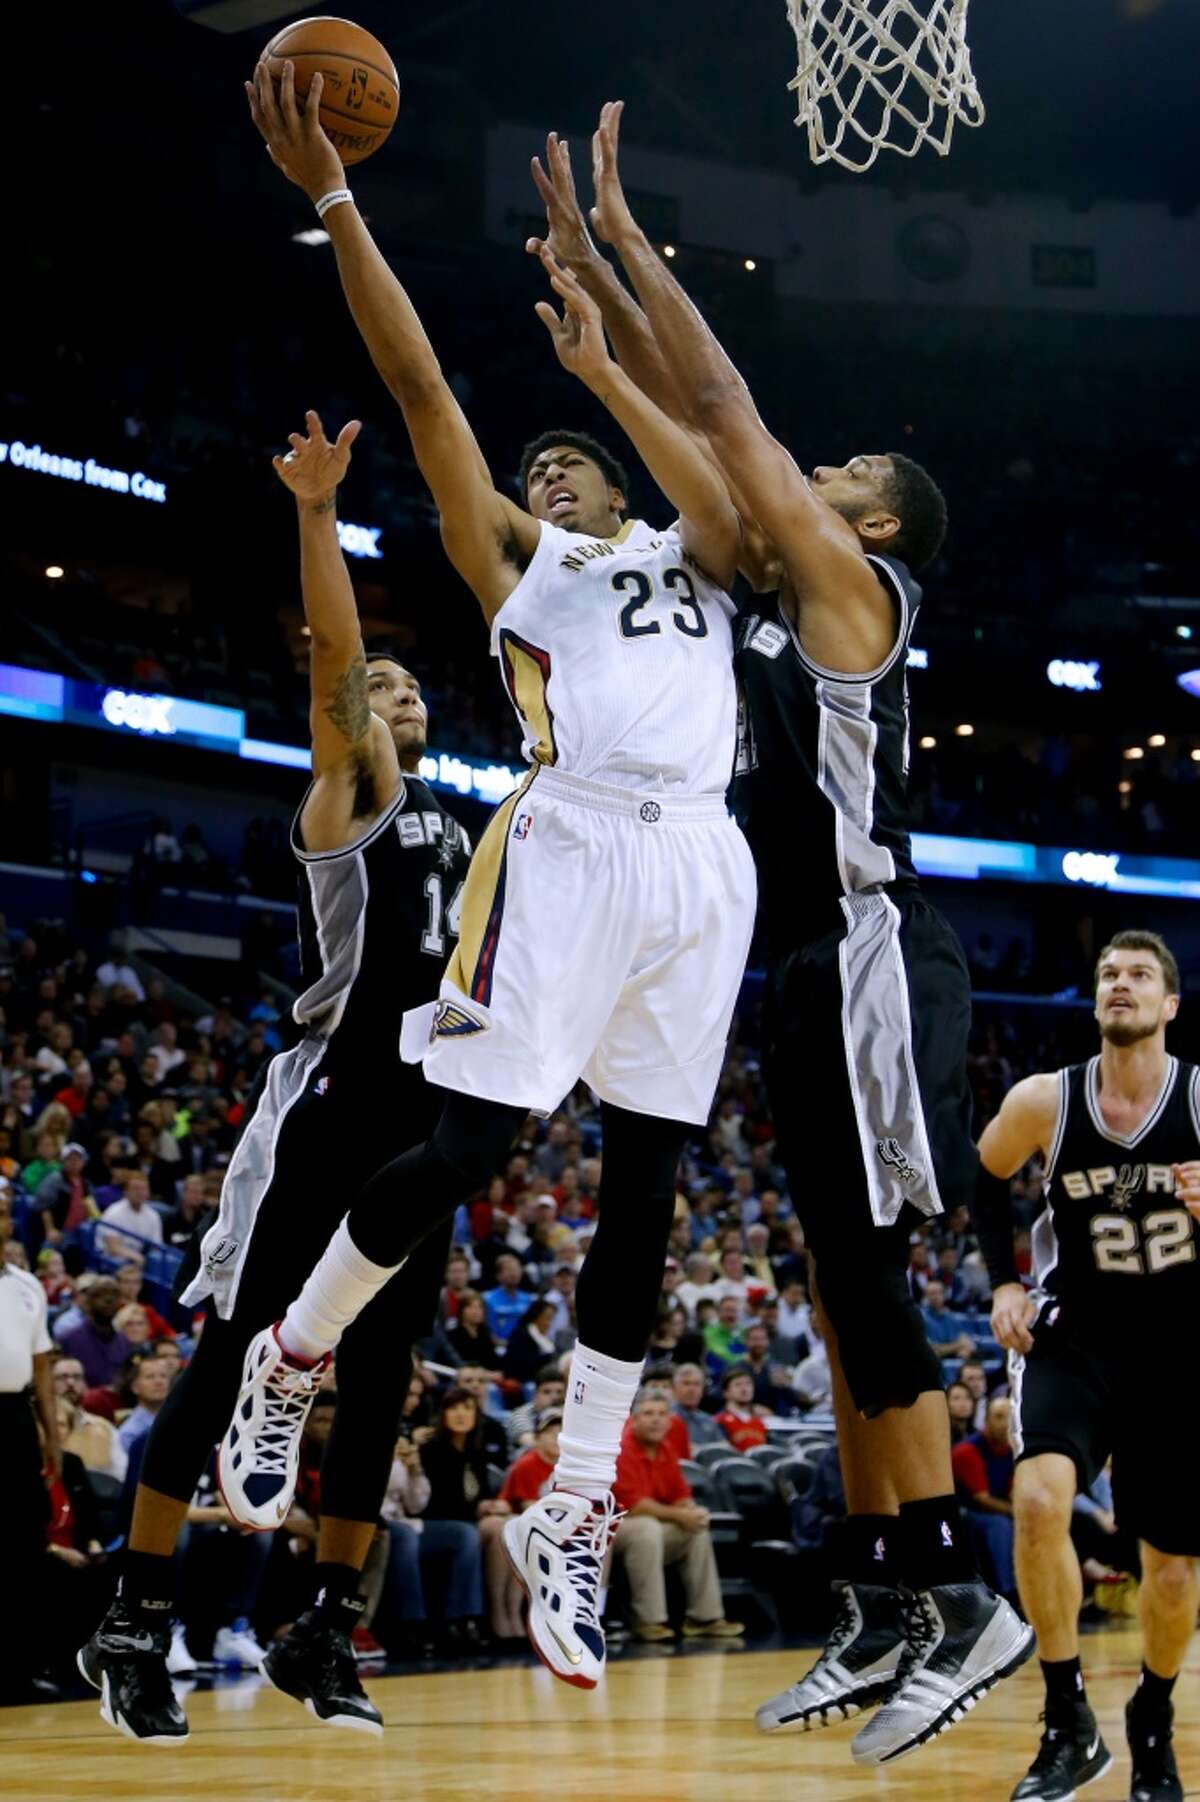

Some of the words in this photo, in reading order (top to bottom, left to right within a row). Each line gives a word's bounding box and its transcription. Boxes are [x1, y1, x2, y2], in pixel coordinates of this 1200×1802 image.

[10, 441, 83, 481] Orleans
[84, 458, 129, 493] from
[131, 472, 166, 503] Cox
[336, 521, 383, 558] OX
[559, 542, 616, 574] NEW
[611, 568, 709, 640] 23
[439, 754, 472, 794] big
[1062, 1163, 1176, 1211] SPUR
[1089, 1209, 1197, 1274] 22
